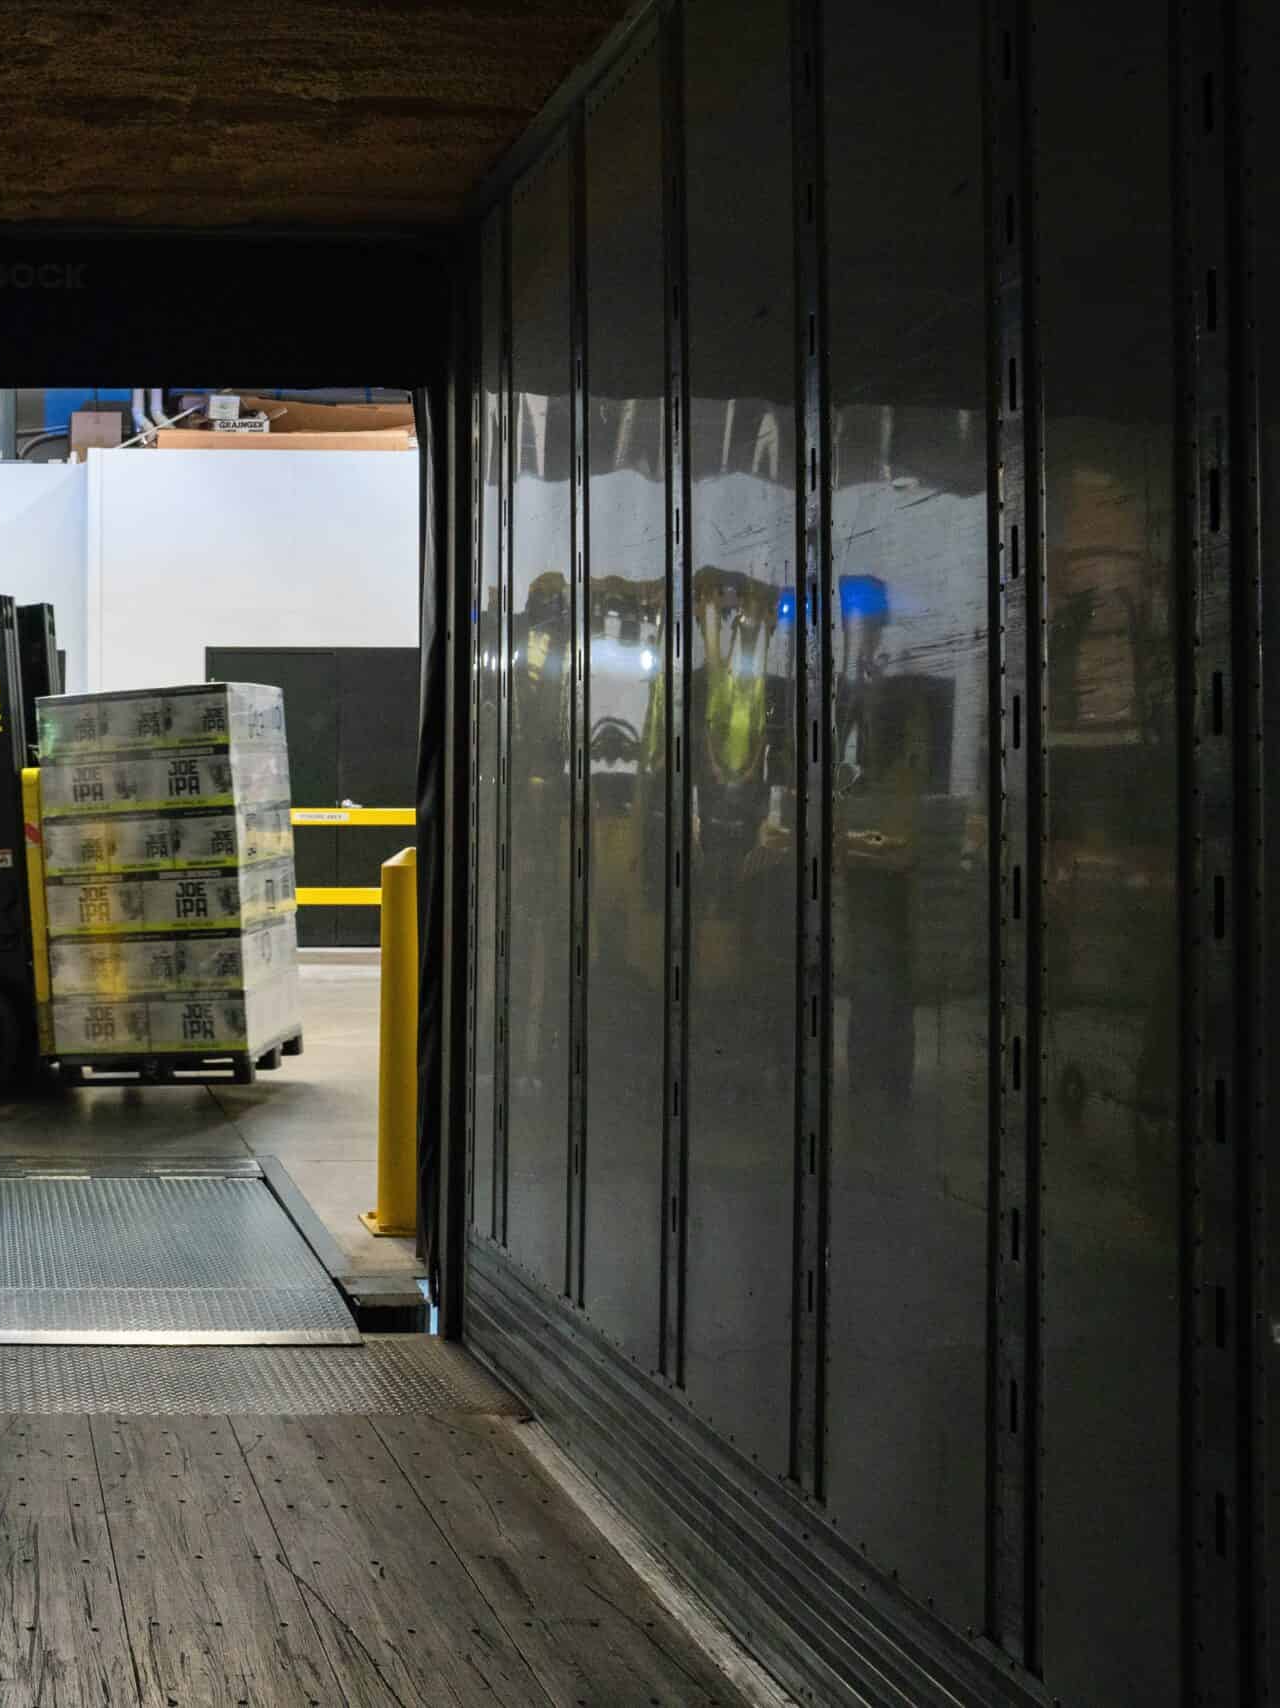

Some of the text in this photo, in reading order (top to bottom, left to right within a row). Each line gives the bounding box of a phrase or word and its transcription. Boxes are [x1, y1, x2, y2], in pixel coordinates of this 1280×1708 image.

[168, 759, 199, 776] JOE
[73, 782, 104, 801] IPA
[168, 777, 201, 796] IPA
[81, 886, 110, 903] JOE
[176, 881, 206, 897] JOE
[80, 902, 111, 922] IPA
[176, 899, 208, 918] IPA
[86, 1005, 113, 1021] JOE
[182, 1003, 213, 1019] JOE
[85, 1022, 115, 1040] IPA
[183, 1019, 215, 1040] IPA
